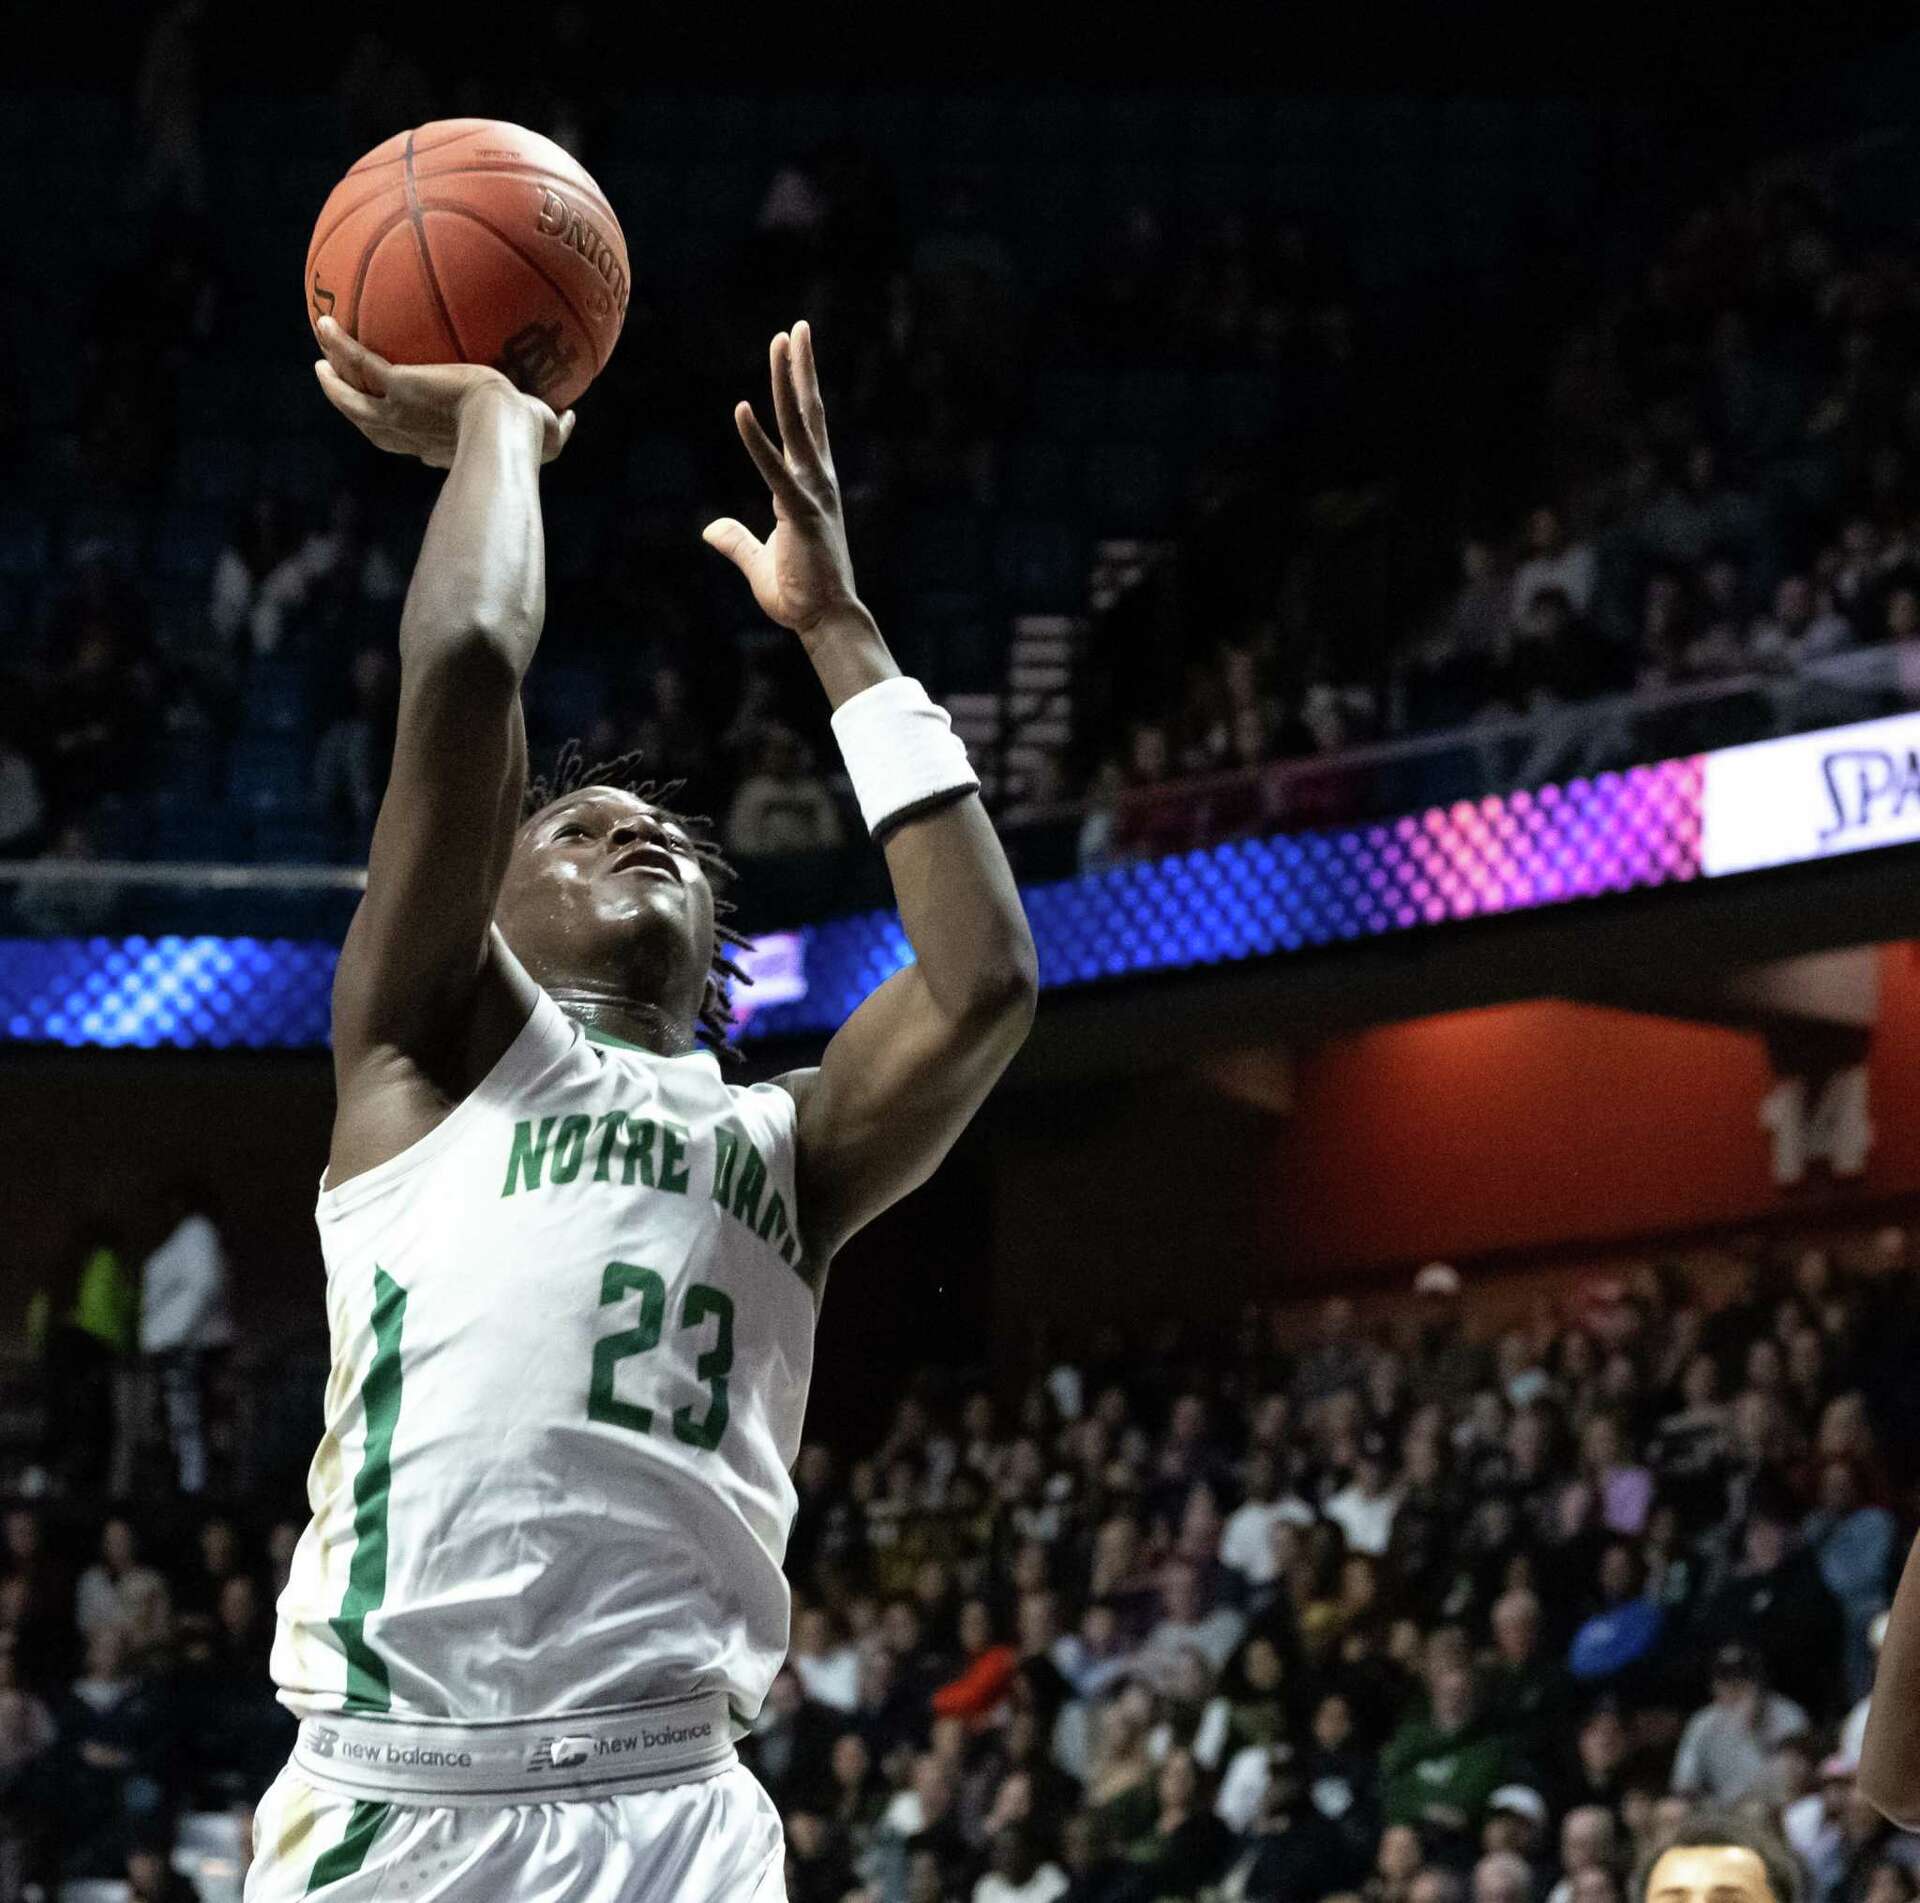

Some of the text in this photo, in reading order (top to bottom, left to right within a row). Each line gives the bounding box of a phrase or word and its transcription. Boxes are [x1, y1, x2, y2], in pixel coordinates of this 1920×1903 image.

[500, 1110, 690, 1198] NOTRE
[587, 1261, 734, 1451] 23
[342, 1741, 381, 1762] new
[386, 1743, 472, 1768] balance
[598, 1737, 637, 1755] new
[642, 1722, 712, 1748] balance
